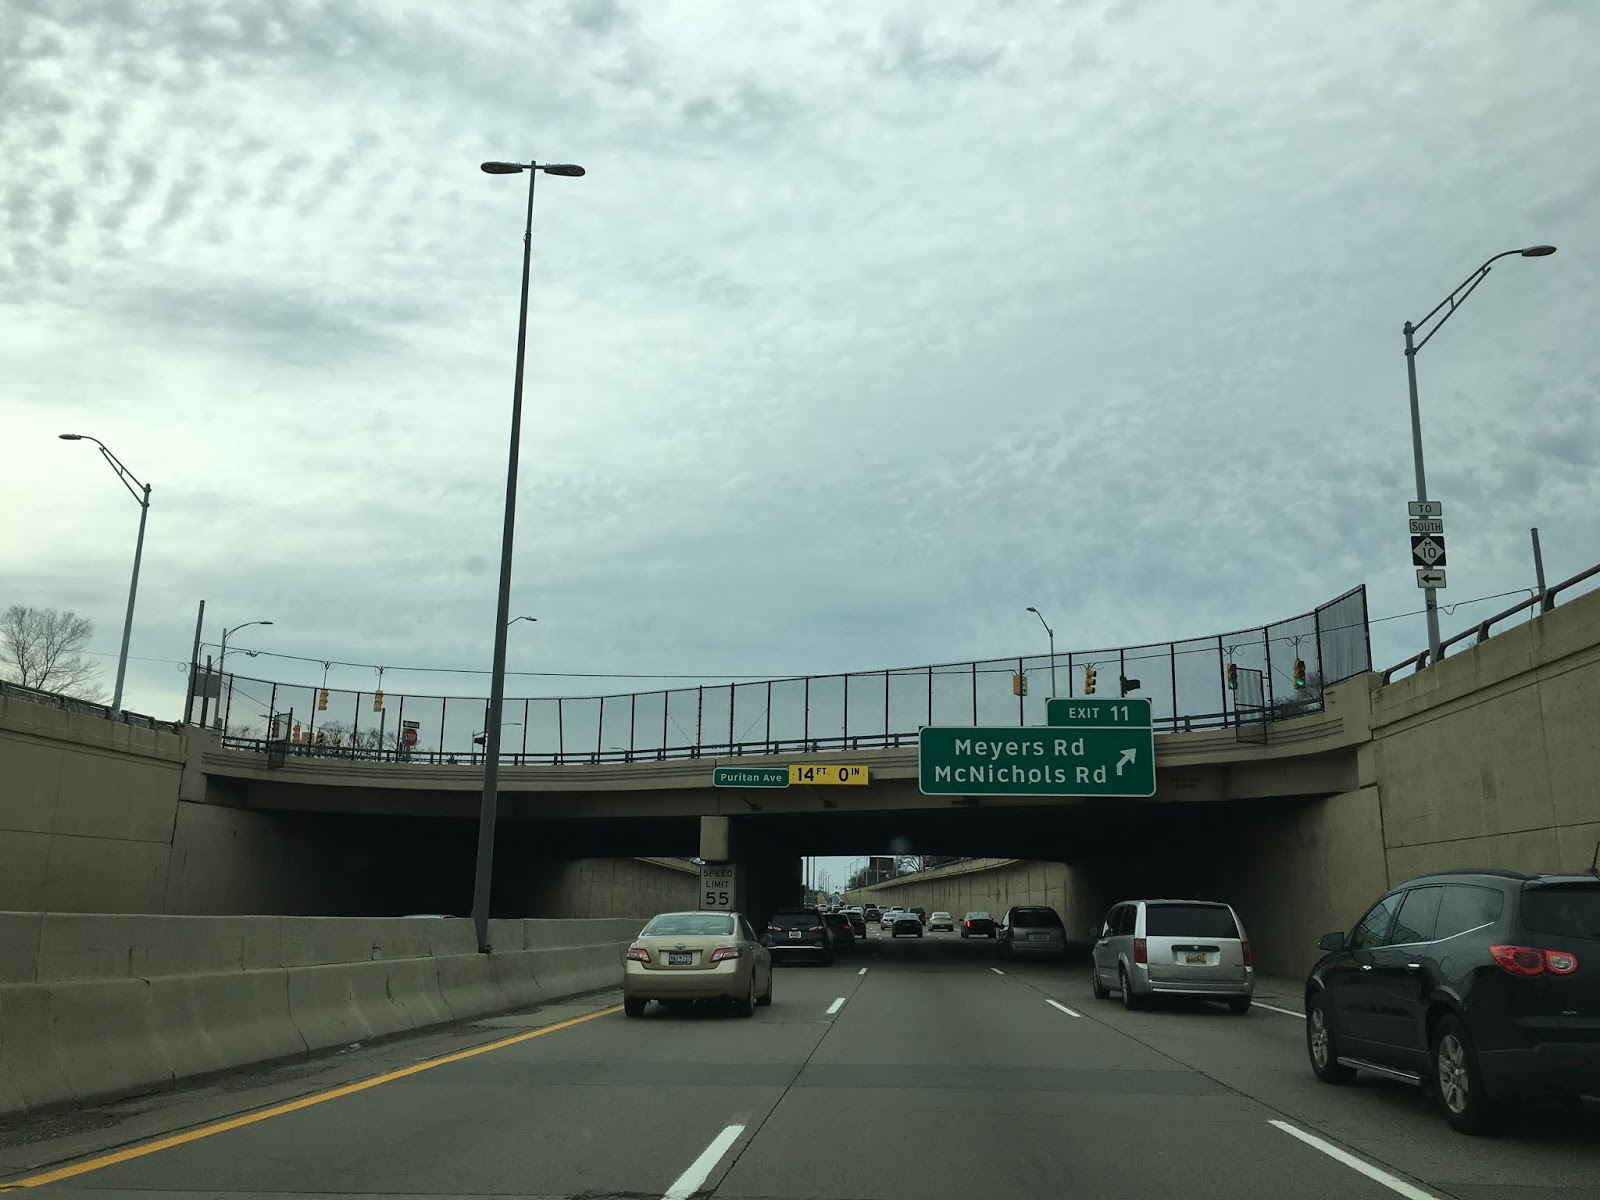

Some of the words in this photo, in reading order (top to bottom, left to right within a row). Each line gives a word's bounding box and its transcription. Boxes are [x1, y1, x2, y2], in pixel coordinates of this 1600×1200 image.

[1419, 504, 1432, 513] TO
[1412, 521, 1440, 531] SOUTH
[1423, 547, 1436, 558] 10
[1069, 707, 1100, 719] EXIT
[1110, 705, 1129, 722] 11
[954, 738, 1044, 760] Meyers
[1054, 738, 1085, 757] Rd
[720, 773, 760, 782] Puritan
[762, 773, 782, 782] Ave
[797, 767, 814, 782] 14
[816, 767, 827, 776] FT
[838, 767, 849, 782] 0
[851, 767, 860, 776] IN
[934, 764, 1066, 784] McNichols
[1076, 765, 1107, 784] Rd
[703, 869, 732, 877] SPEED
[706, 892, 729, 905] 55
